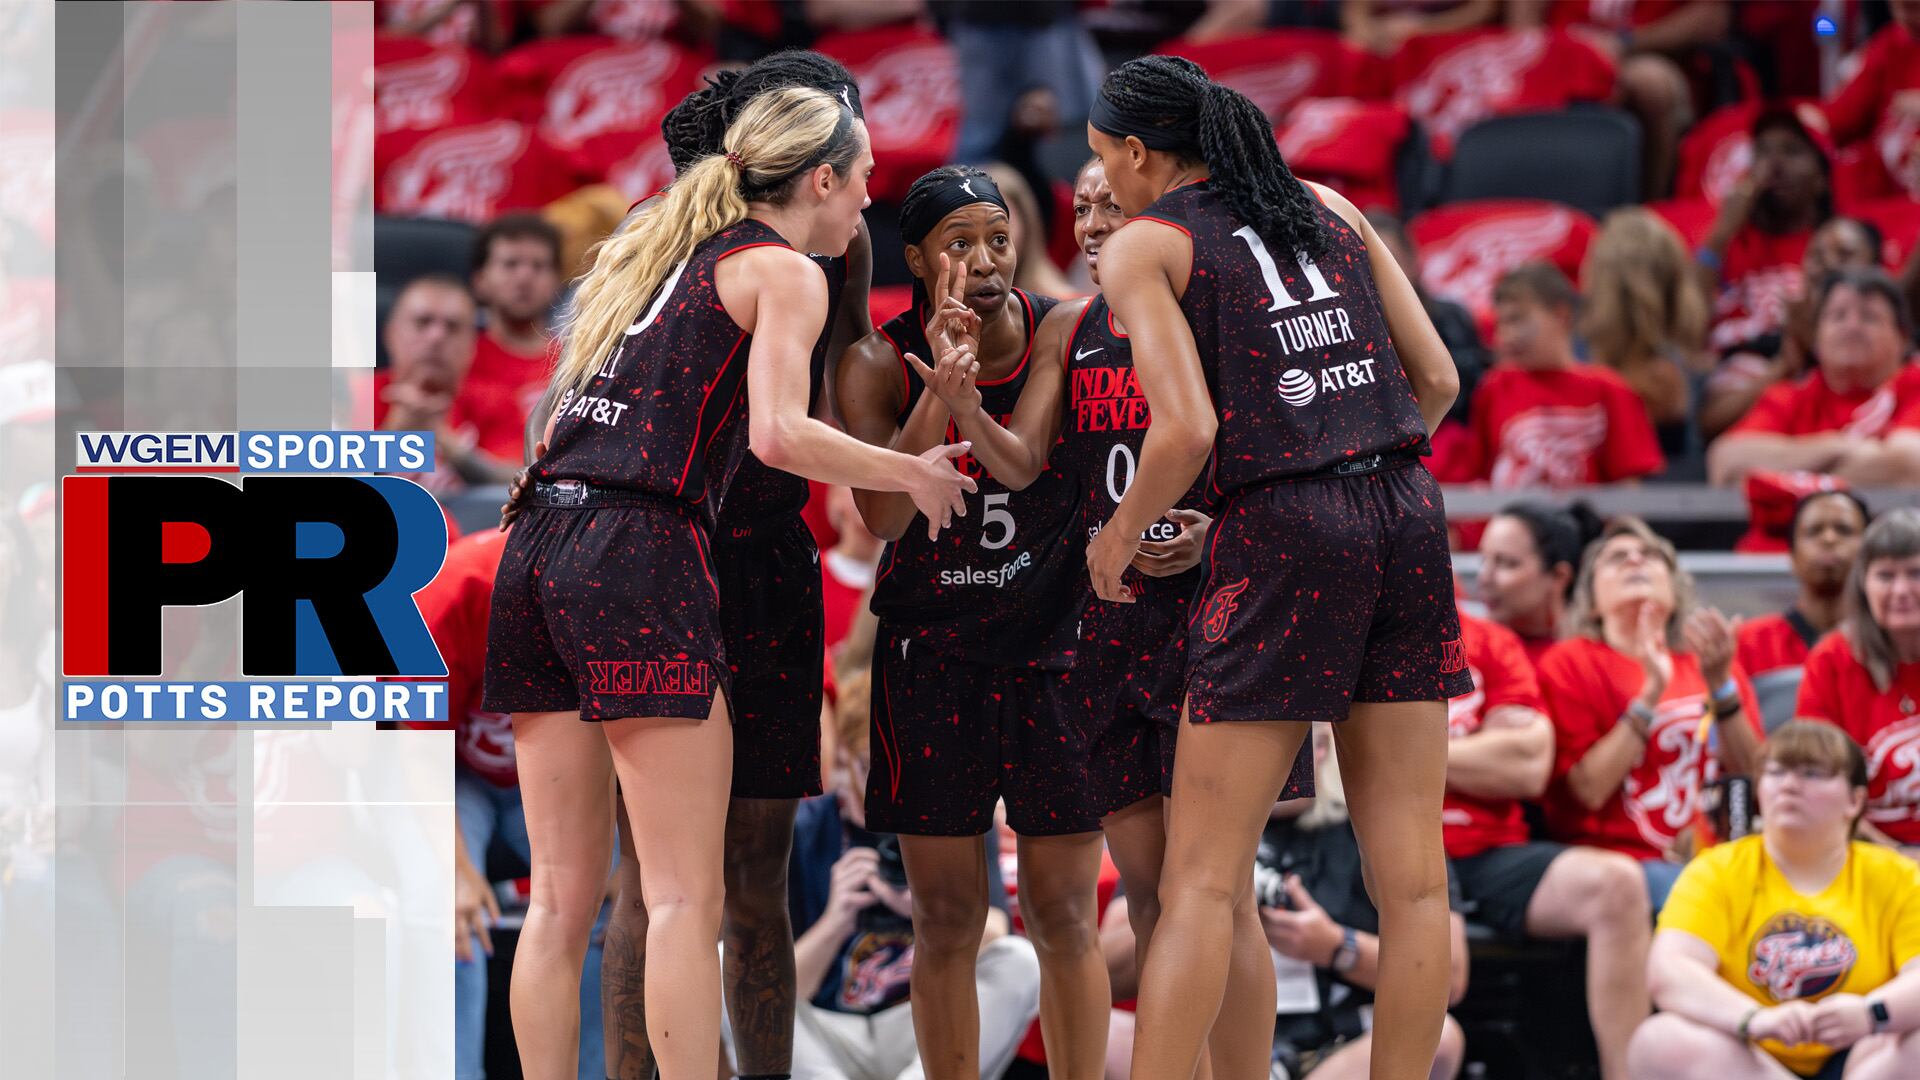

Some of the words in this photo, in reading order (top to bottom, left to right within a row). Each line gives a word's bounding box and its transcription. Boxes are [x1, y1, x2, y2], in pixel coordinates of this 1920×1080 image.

[1271, 307, 1355, 355] TURNER
[1072, 367, 1144, 410] INDIA
[1321, 358, 1376, 393] AT&T
[568, 396, 629, 427] AT&T
[1077, 397, 1152, 433] FEVE
[1106, 443, 1136, 504] 0
[979, 492, 1016, 550] 5
[940, 550, 1032, 587] salesforce
[586, 661, 710, 696] FEVER
